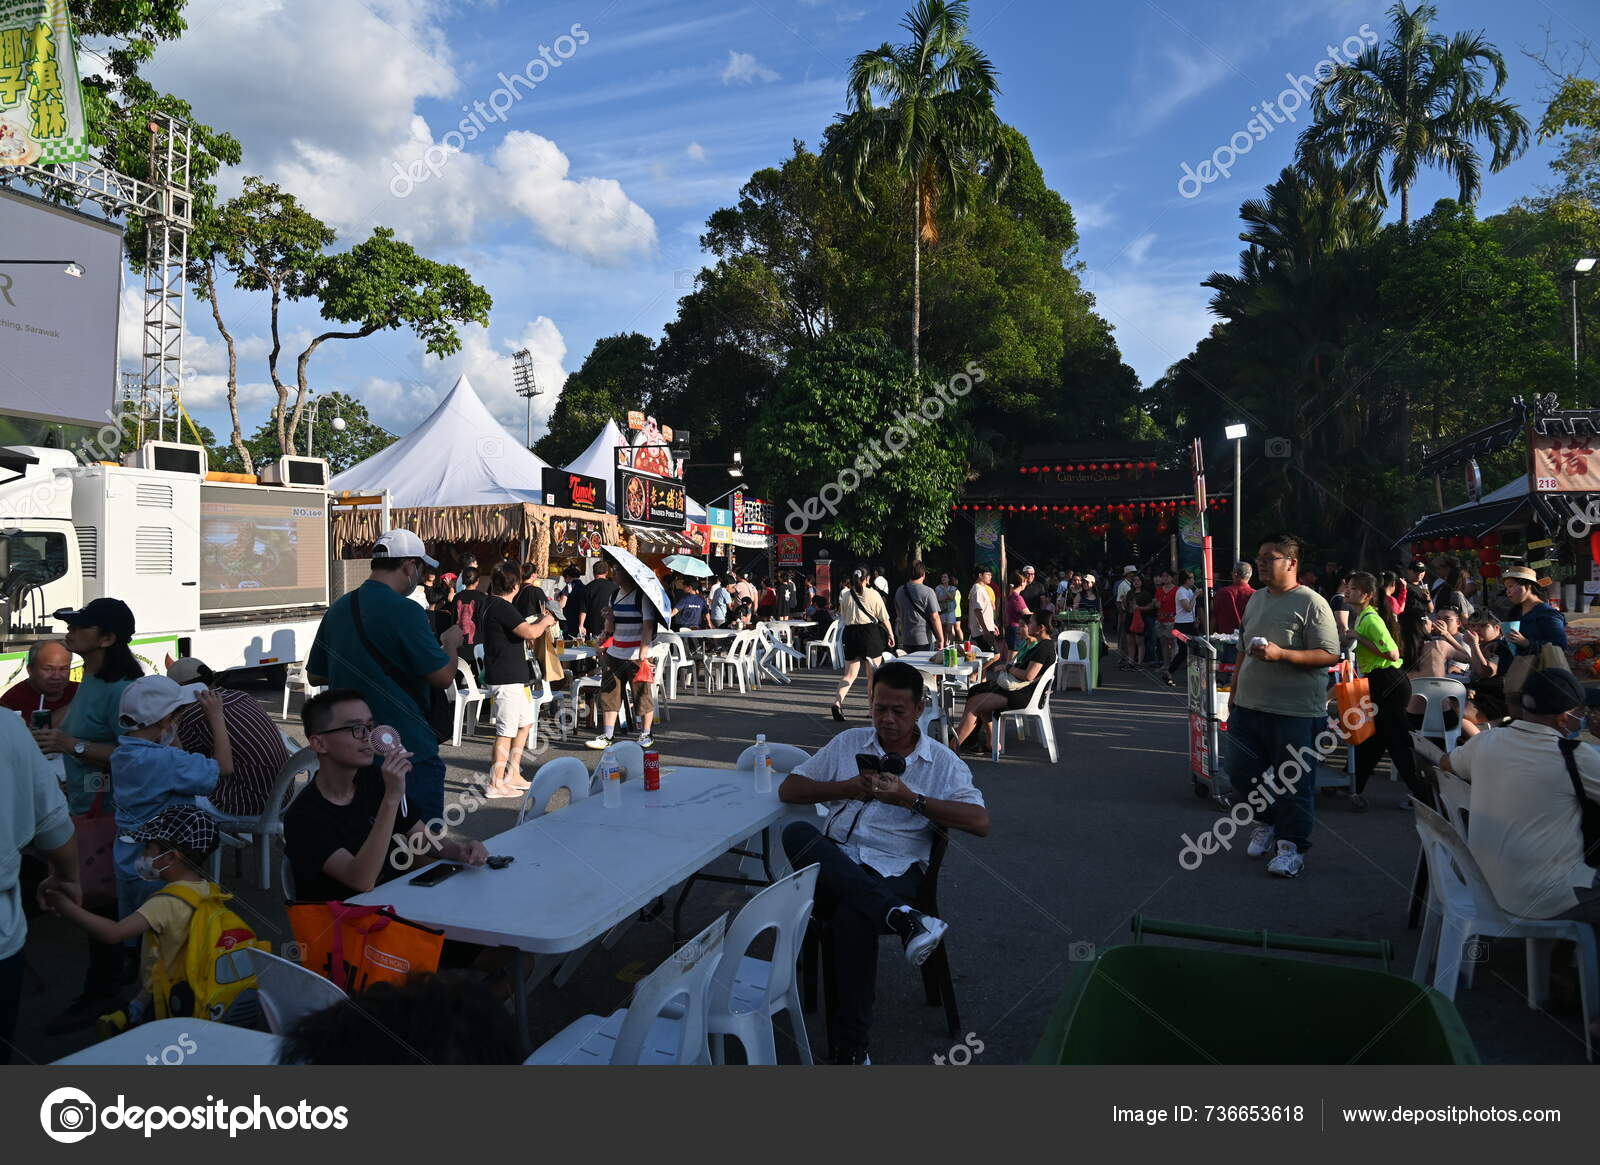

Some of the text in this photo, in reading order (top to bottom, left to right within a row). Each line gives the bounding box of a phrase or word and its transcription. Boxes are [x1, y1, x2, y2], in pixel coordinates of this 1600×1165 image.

[23, 22, 66, 139] 冰淇淋
[25, 324, 60, 337] Sarawak
[1538, 480, 1557, 489] 218
